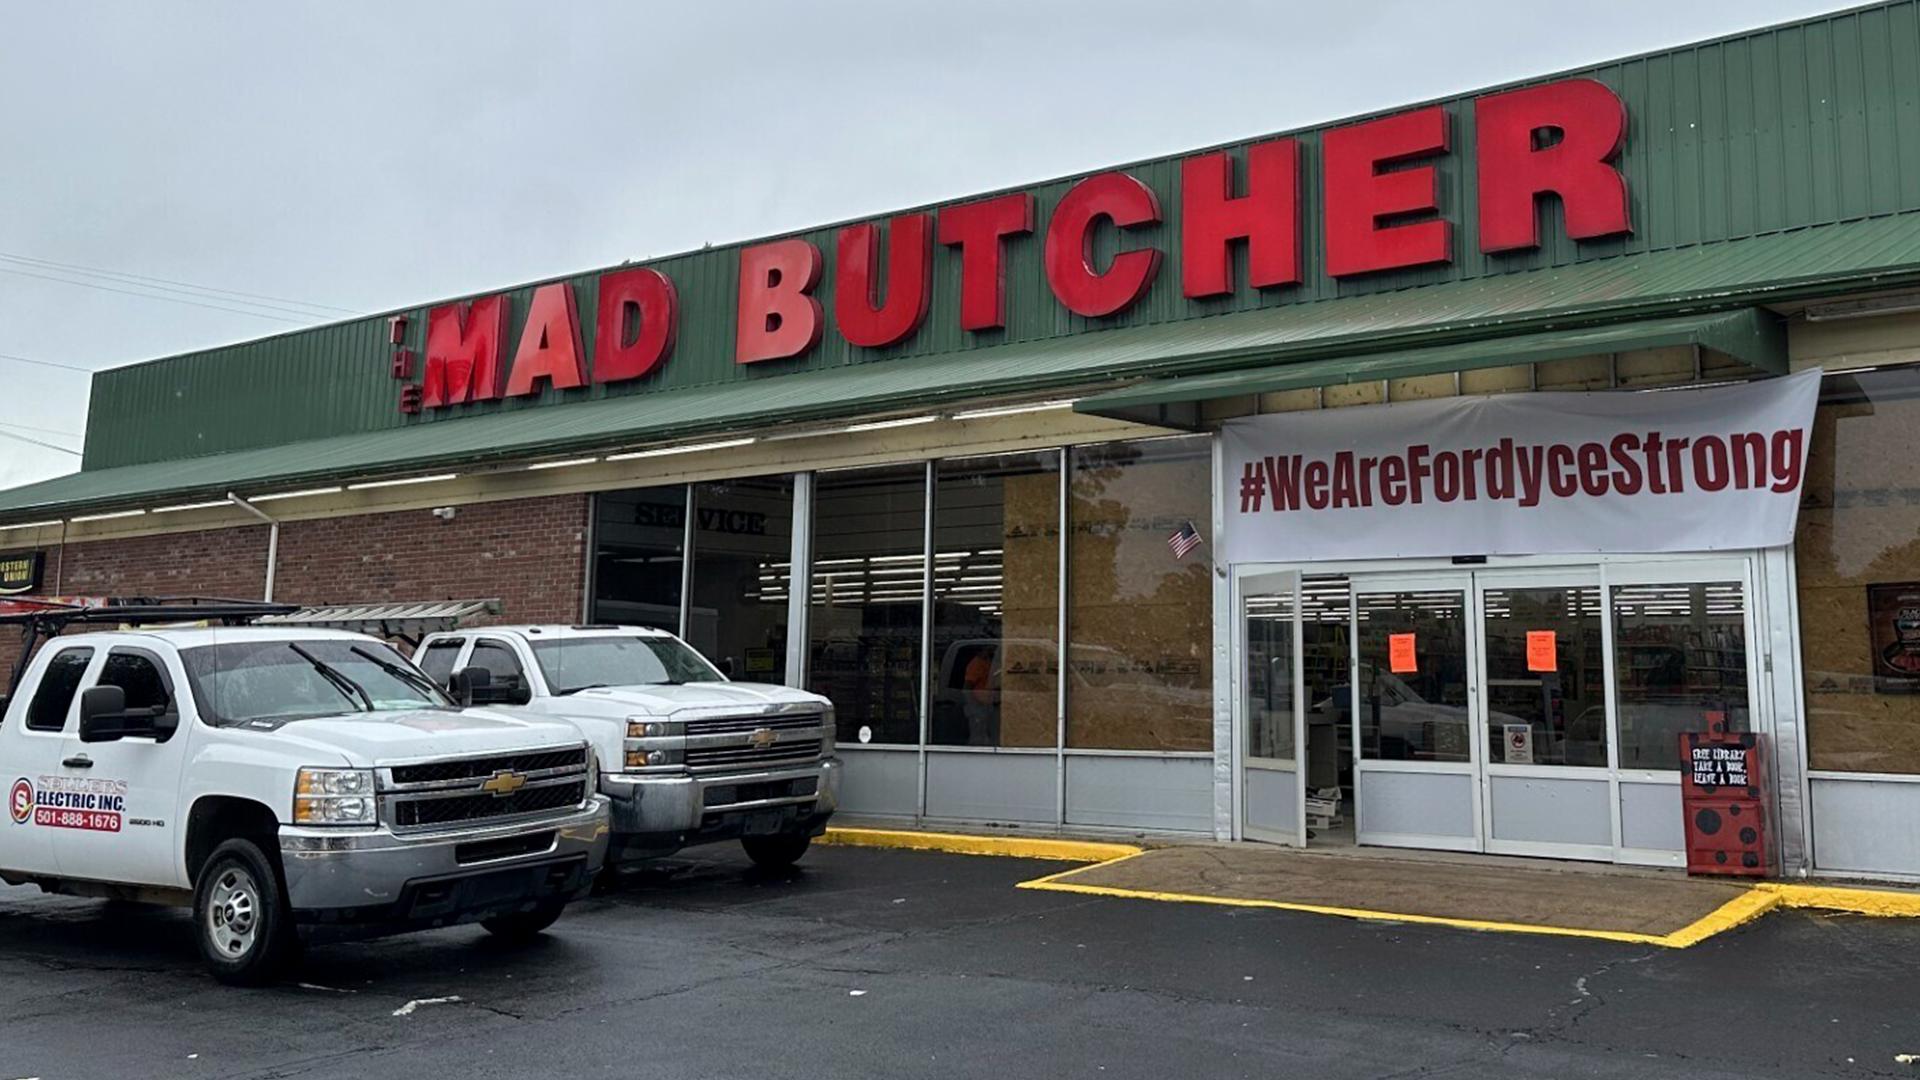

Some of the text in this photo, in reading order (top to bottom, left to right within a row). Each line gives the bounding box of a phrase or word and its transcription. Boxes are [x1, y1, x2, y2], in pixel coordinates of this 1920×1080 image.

[422, 78, 1633, 408] MAD BUTCHER
[387, 316, 422, 413] THE
[1240, 428, 1803, 512] #WeAreFordyceStrong
[0, 560, 29, 572] ESTERN
[1692, 748, 1746, 760] FREE LIBRARY
[1693, 761, 1713, 772] TAKE
[1716, 761, 1723, 772] A
[1694, 773, 1747, 785] LEAVE A BOOK
[36, 791, 126, 812] ELECTRIC INC.
[37, 810, 118, 829] 501-888-1676
